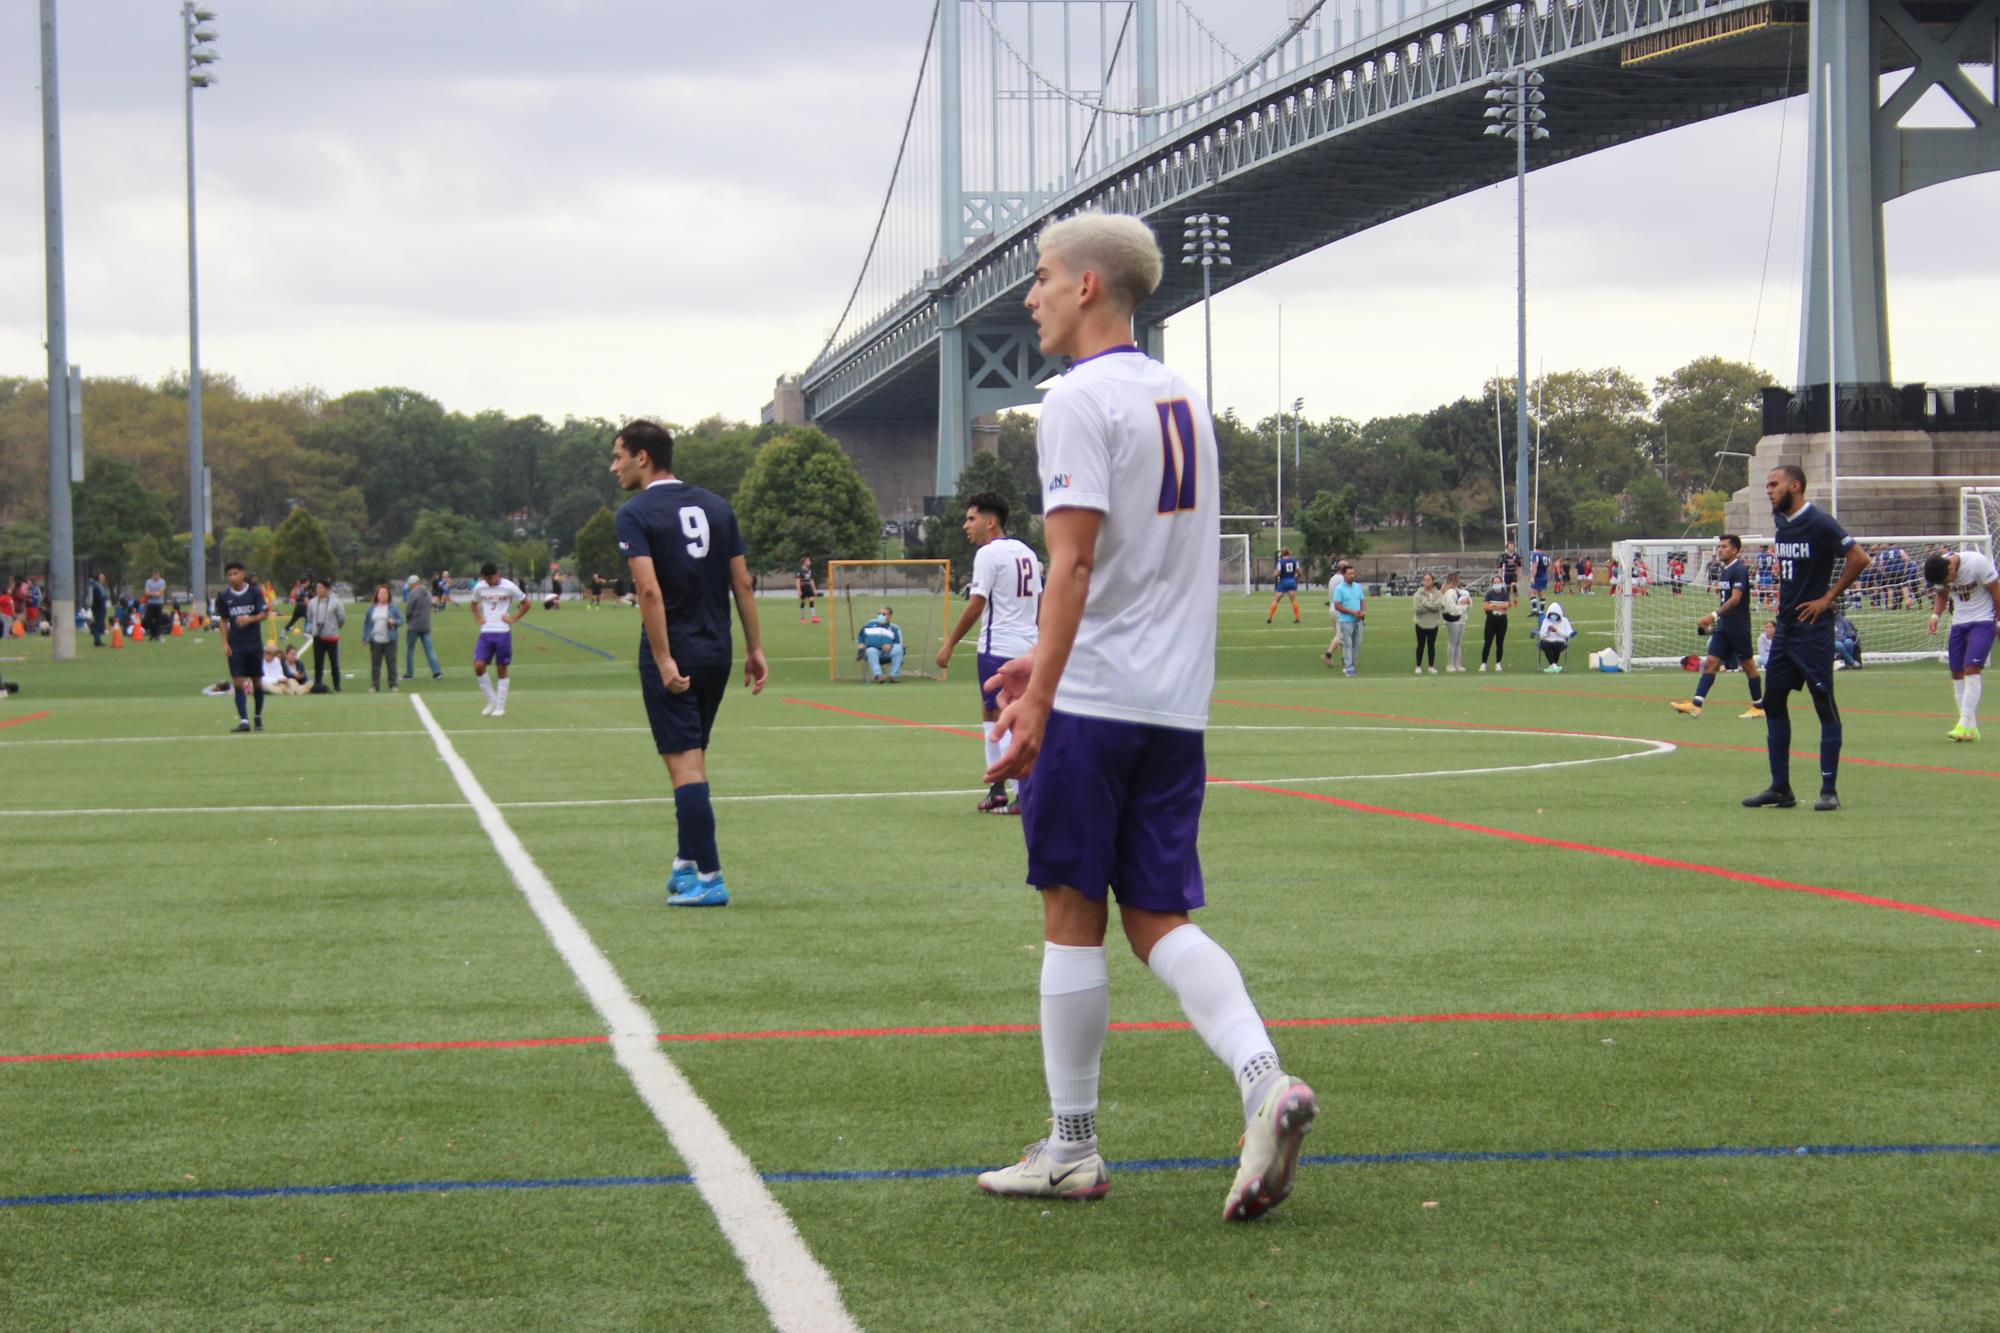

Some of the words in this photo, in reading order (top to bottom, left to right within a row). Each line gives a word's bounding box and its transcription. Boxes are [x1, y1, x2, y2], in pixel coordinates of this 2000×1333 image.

[1155, 396, 1197, 516] 11
[678, 505, 711, 560] 9
[1775, 542, 1810, 558] ARUCH
[1015, 557, 1033, 598] 12
[1781, 560, 1793, 580] 11
